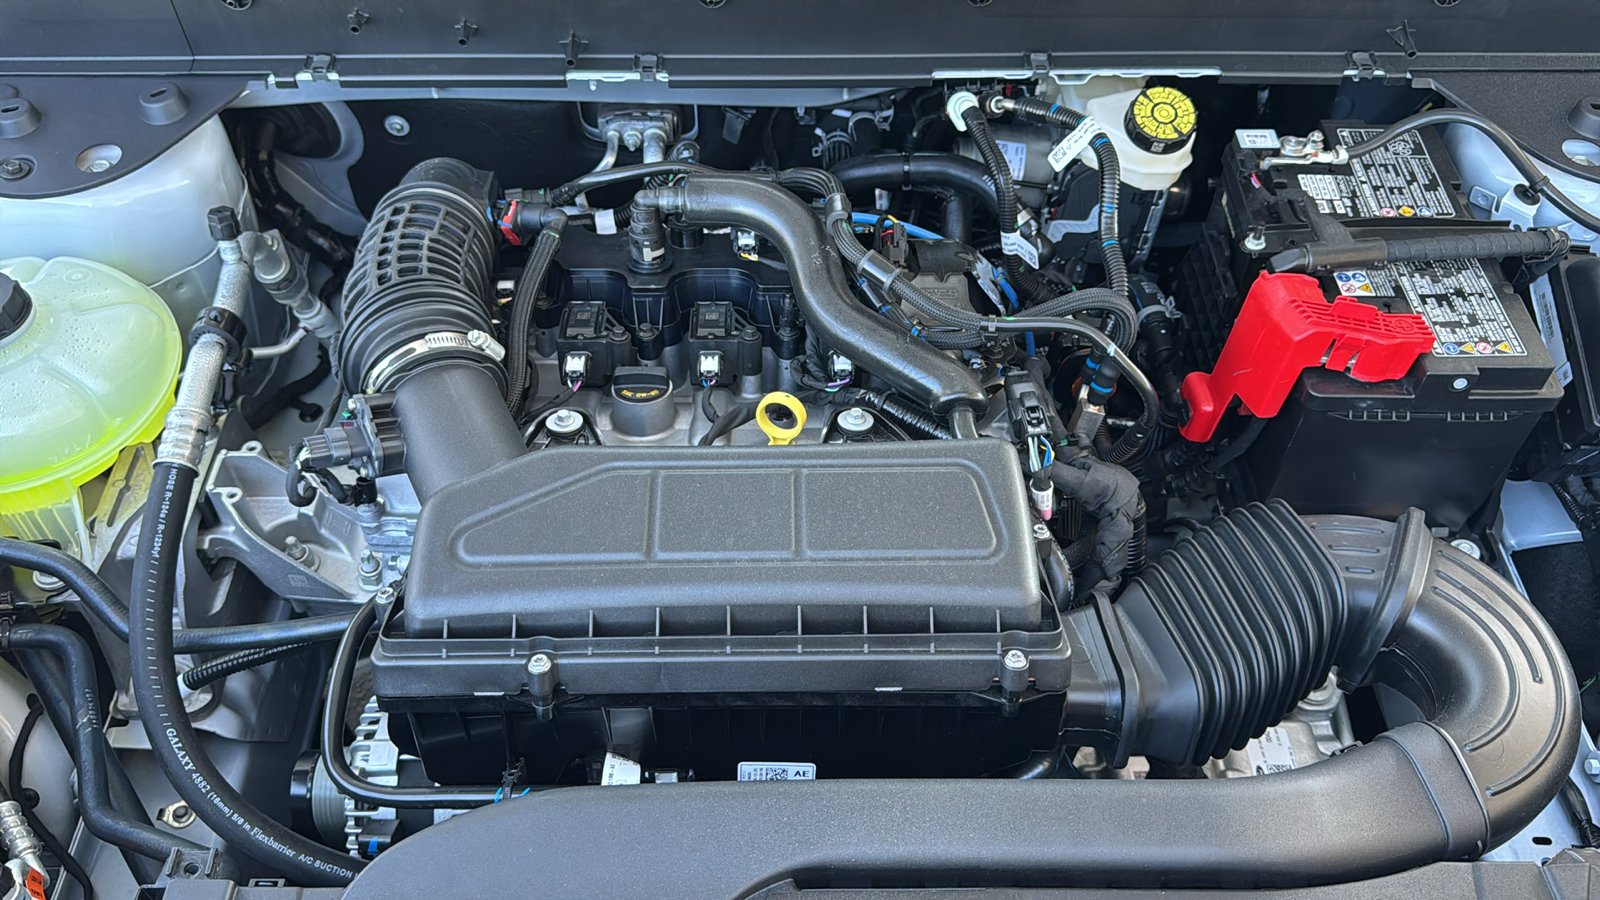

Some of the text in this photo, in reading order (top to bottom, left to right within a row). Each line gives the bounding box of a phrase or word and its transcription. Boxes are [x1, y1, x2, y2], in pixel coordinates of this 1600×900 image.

[166, 468, 178, 490] HOSE
[159, 491, 173, 518] R-134a
[151, 524, 166, 558] R-1234yf
[793, 770, 810, 778] AE
[166, 728, 196, 771] GALAXY
[191, 772, 211, 793] 4882
[207, 791, 234, 817] (16mm)
[231, 813, 245, 825] 5/8
[250, 827, 296, 857] Flexbarrier
[298, 853, 314, 865] A/C
[313, 859, 353, 879] SUCTION
